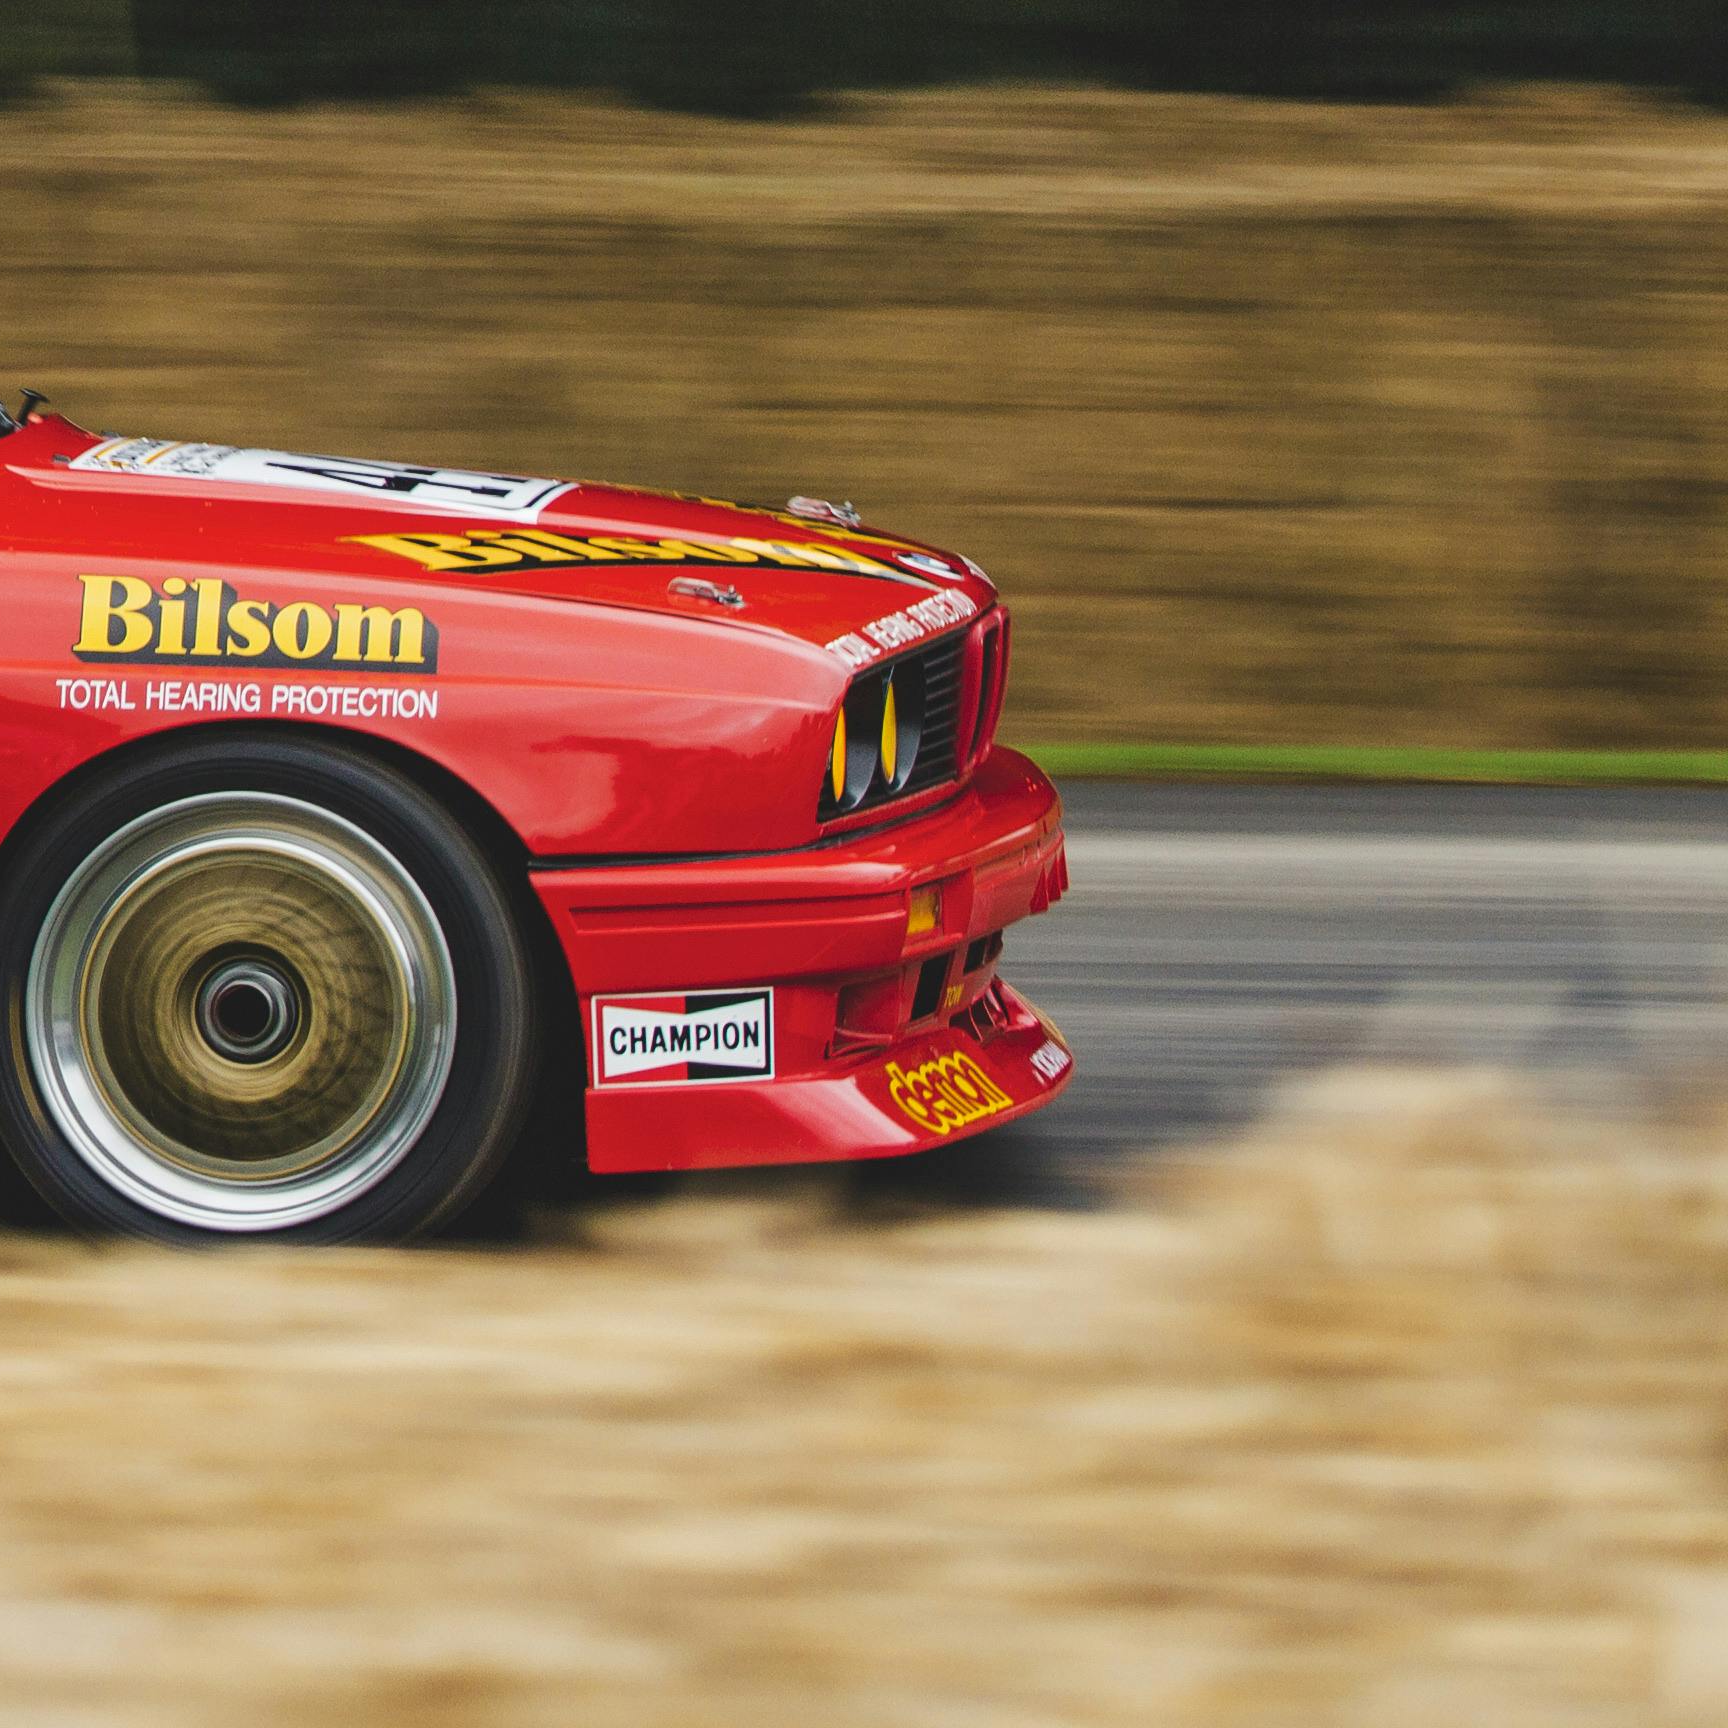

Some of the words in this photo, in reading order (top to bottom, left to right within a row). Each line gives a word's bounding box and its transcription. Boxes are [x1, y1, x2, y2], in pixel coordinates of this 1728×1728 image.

[72, 573, 426, 665] Bilsom
[55, 678, 136, 711] TOTAL
[145, 680, 262, 714] HEARING
[271, 683, 438, 719] PROTECTION
[609, 1020, 760, 1055] CHAMPION
[884, 1050, 1015, 1136] demon
